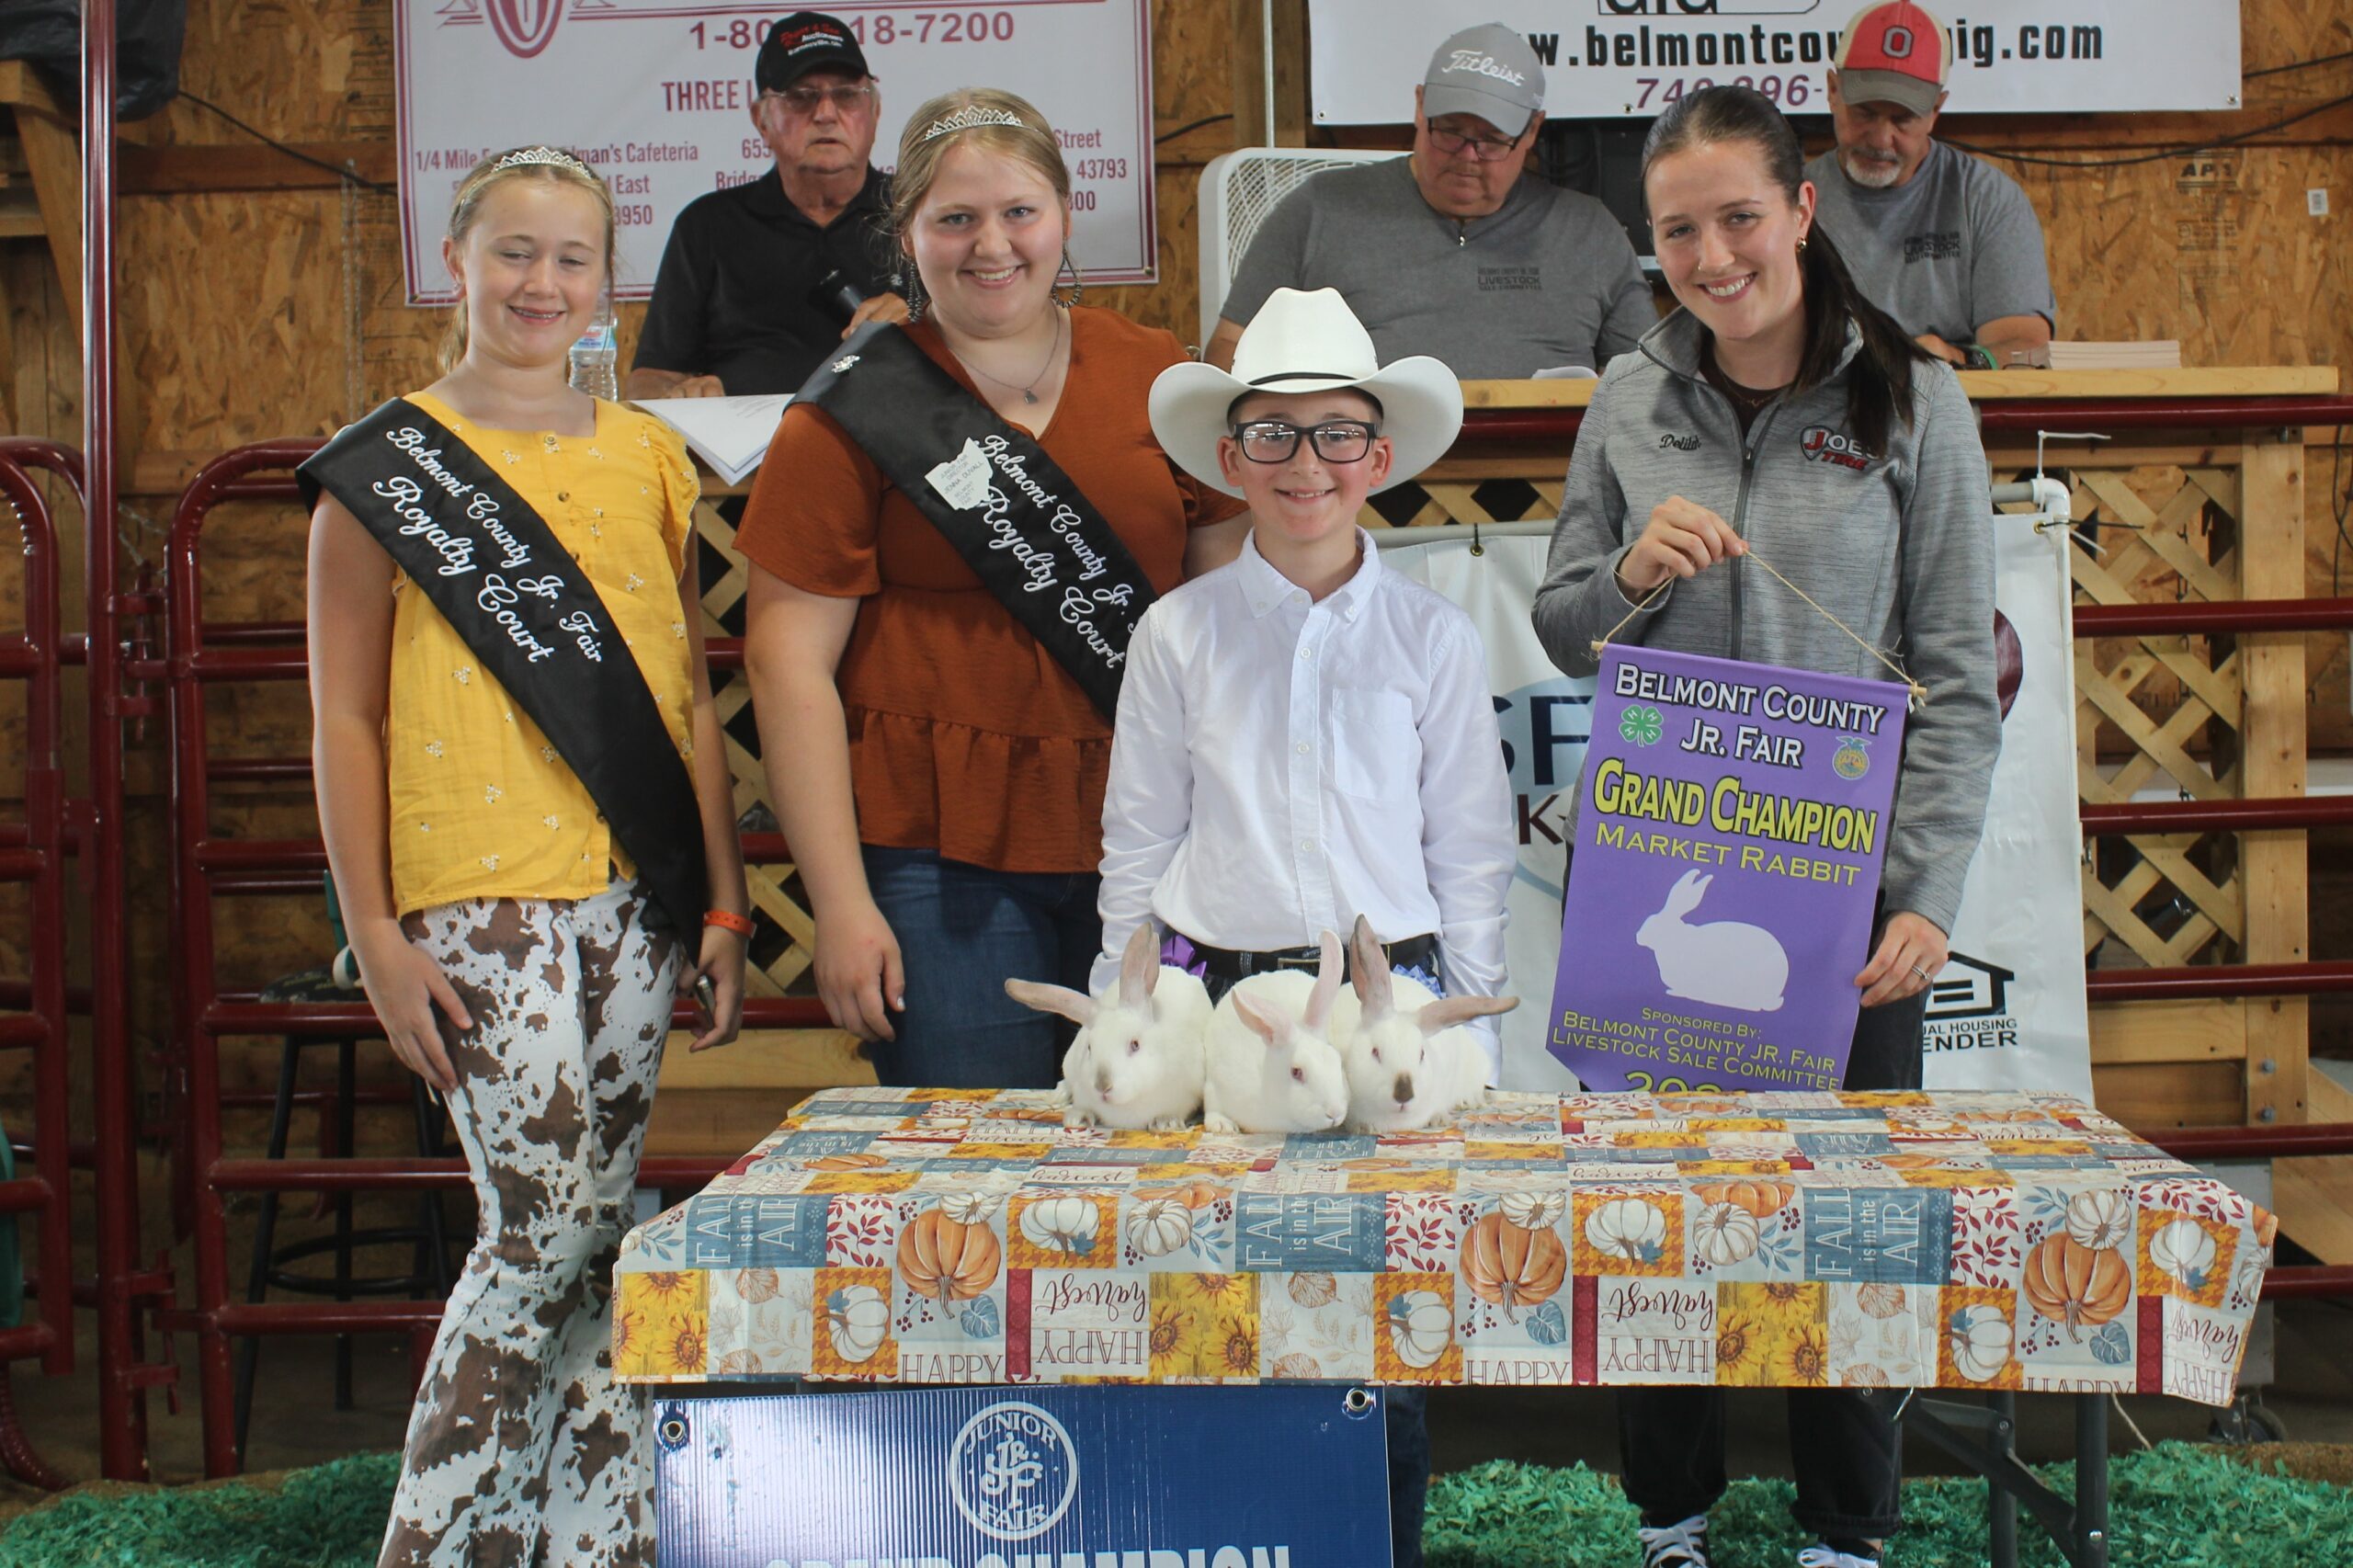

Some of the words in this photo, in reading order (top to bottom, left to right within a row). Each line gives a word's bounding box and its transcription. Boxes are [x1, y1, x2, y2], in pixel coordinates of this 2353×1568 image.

[1440, 50, 1526, 87] Titleist
[661, 80, 739, 111] THREE
[626, 138, 699, 163] Cafeteria
[1053, 129, 1102, 148] Street
[415, 150, 441, 172] 1/4
[445, 147, 477, 169] Mile
[1076, 158, 1127, 179] 43793
[616, 175, 651, 194] East
[1476, 276, 1541, 286] LIVESTOCK
[975, 434, 1058, 508] Belmont
[1051, 504, 1107, 581] County
[1093, 584, 1134, 616] Jr.
[386, 426, 474, 497] Belmont
[466, 492, 531, 569] County
[517, 574, 564, 609] Jr.
[559, 610, 602, 663] Fair
[372, 476, 477, 576] Royalty
[477, 574, 554, 663] Court
[979, 484, 1058, 593] Royalty
[1060, 586, 1126, 669] Court
[1615, 662, 1758, 716] BELMONT
[1762, 685, 1886, 735] COUNTY
[1680, 718, 1728, 756] JR.
[1735, 724, 1804, 768] FAIR
[1593, 757, 1707, 827] GRAND
[1710, 776, 1879, 854] CHAMPION
[1596, 822, 1733, 867] MARKET
[1739, 846, 1862, 887] RABBIT
[1641, 1007, 1733, 1035] SPONSORED
[1736, 1024, 1763, 1040] BY:
[1949, 1018, 2018, 1033] HOUSING
[1563, 1010, 1659, 1041] BELMONT
[1663, 1028, 1747, 1057] COUNTY
[1750, 1044, 1783, 1064] JR.
[1790, 1050, 1836, 1074] FAIR
[1923, 1030, 2018, 1053] ENDER
[1552, 1027, 1661, 1061] LIVESTOCK
[1666, 1046, 1718, 1072] SALE
[1722, 1057, 1841, 1092] COMMITTEE
[736, 1215, 754, 1229] in
[1290, 1197, 1308, 1214] th
[1859, 1200, 1877, 1223] the
[736, 1234, 754, 1247] is
[757, 1198, 801, 1252] AIR
[1289, 1220, 1307, 1232] in
[1313, 1197, 1353, 1256] AIR
[1814, 1187, 1853, 1278] FALL
[1859, 1230, 1877, 1244] in
[1881, 1200, 1920, 1267] AIR
[1289, 1237, 1307, 1250] is
[1859, 1248, 1877, 1261] is
[1035, 1273, 1146, 1323] harvest
[1601, 1287, 1714, 1332] harvest
[1035, 1330, 1143, 1365] HAPPY
[1602, 1337, 1711, 1374] HAPPY
[901, 1353, 1005, 1383] HAPPY
[1466, 1358, 1571, 1386] HAPPY
[2168, 1358, 2228, 1405] HAPPY
[966, 1411, 1057, 1455] JUNIOR
[977, 1499, 1051, 1530] FAIR
